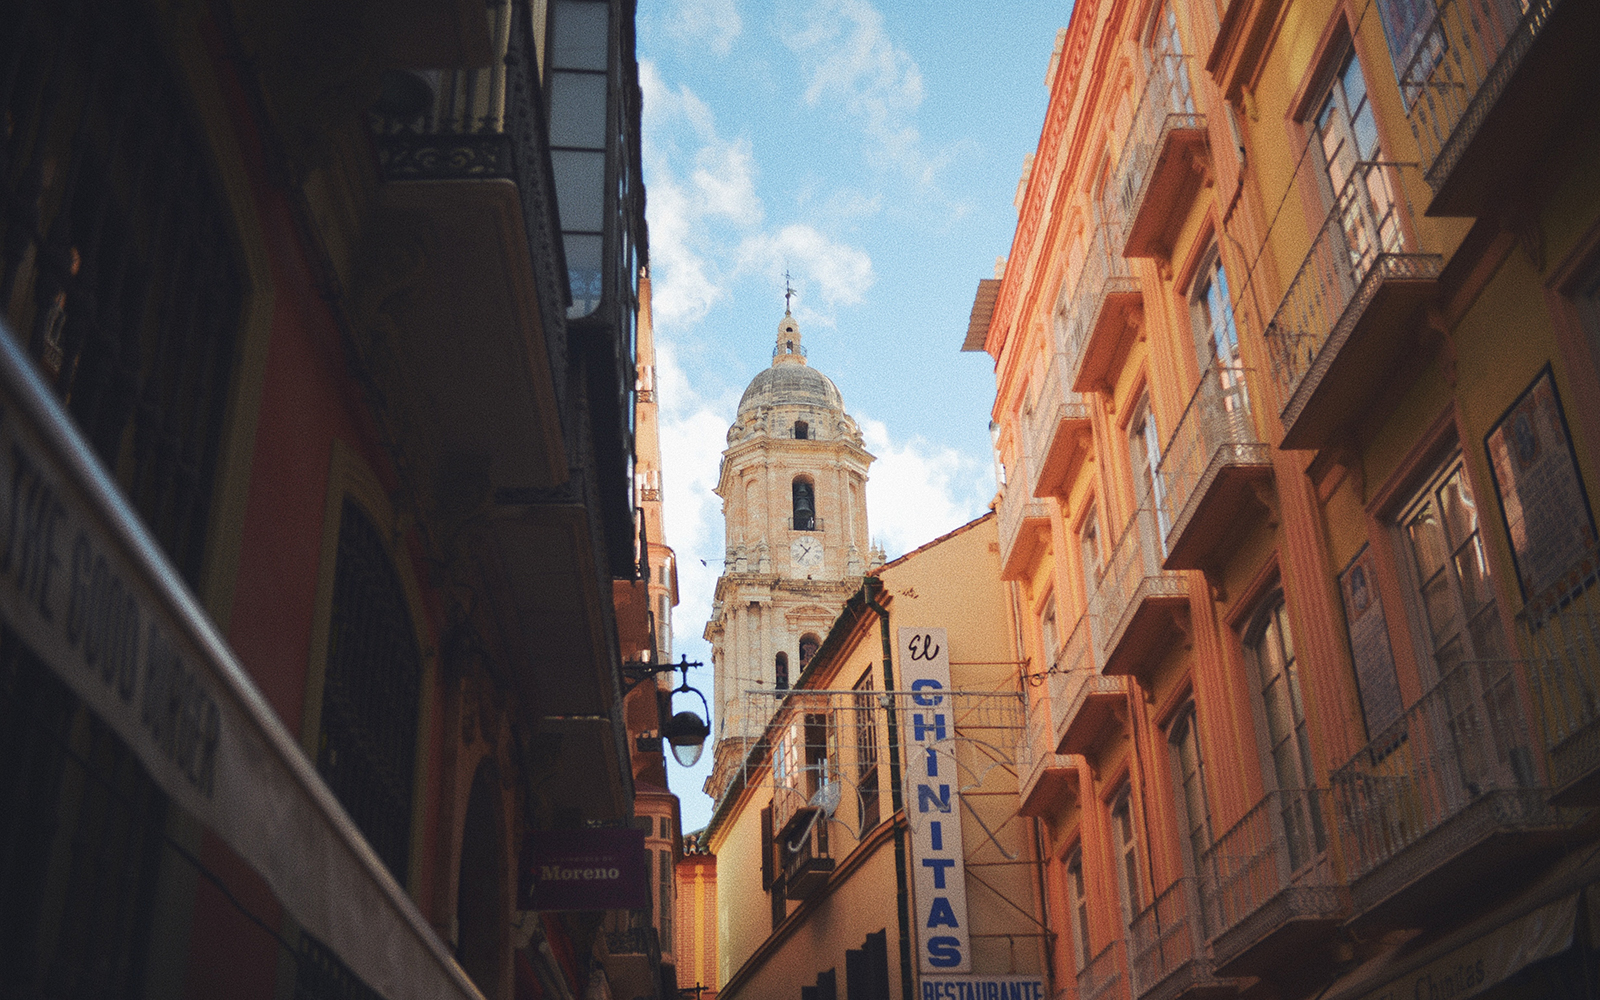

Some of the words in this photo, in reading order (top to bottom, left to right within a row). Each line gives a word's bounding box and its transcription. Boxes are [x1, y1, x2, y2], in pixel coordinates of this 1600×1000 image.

[2, 442, 67, 622] THE
[67, 529, 140, 703] GOOD
[908, 634, 939, 661] El
[911, 679, 962, 968] CHINITAS
[541, 865, 620, 880] Moreno
[922, 981, 1042, 1000] RESTAURANTE
